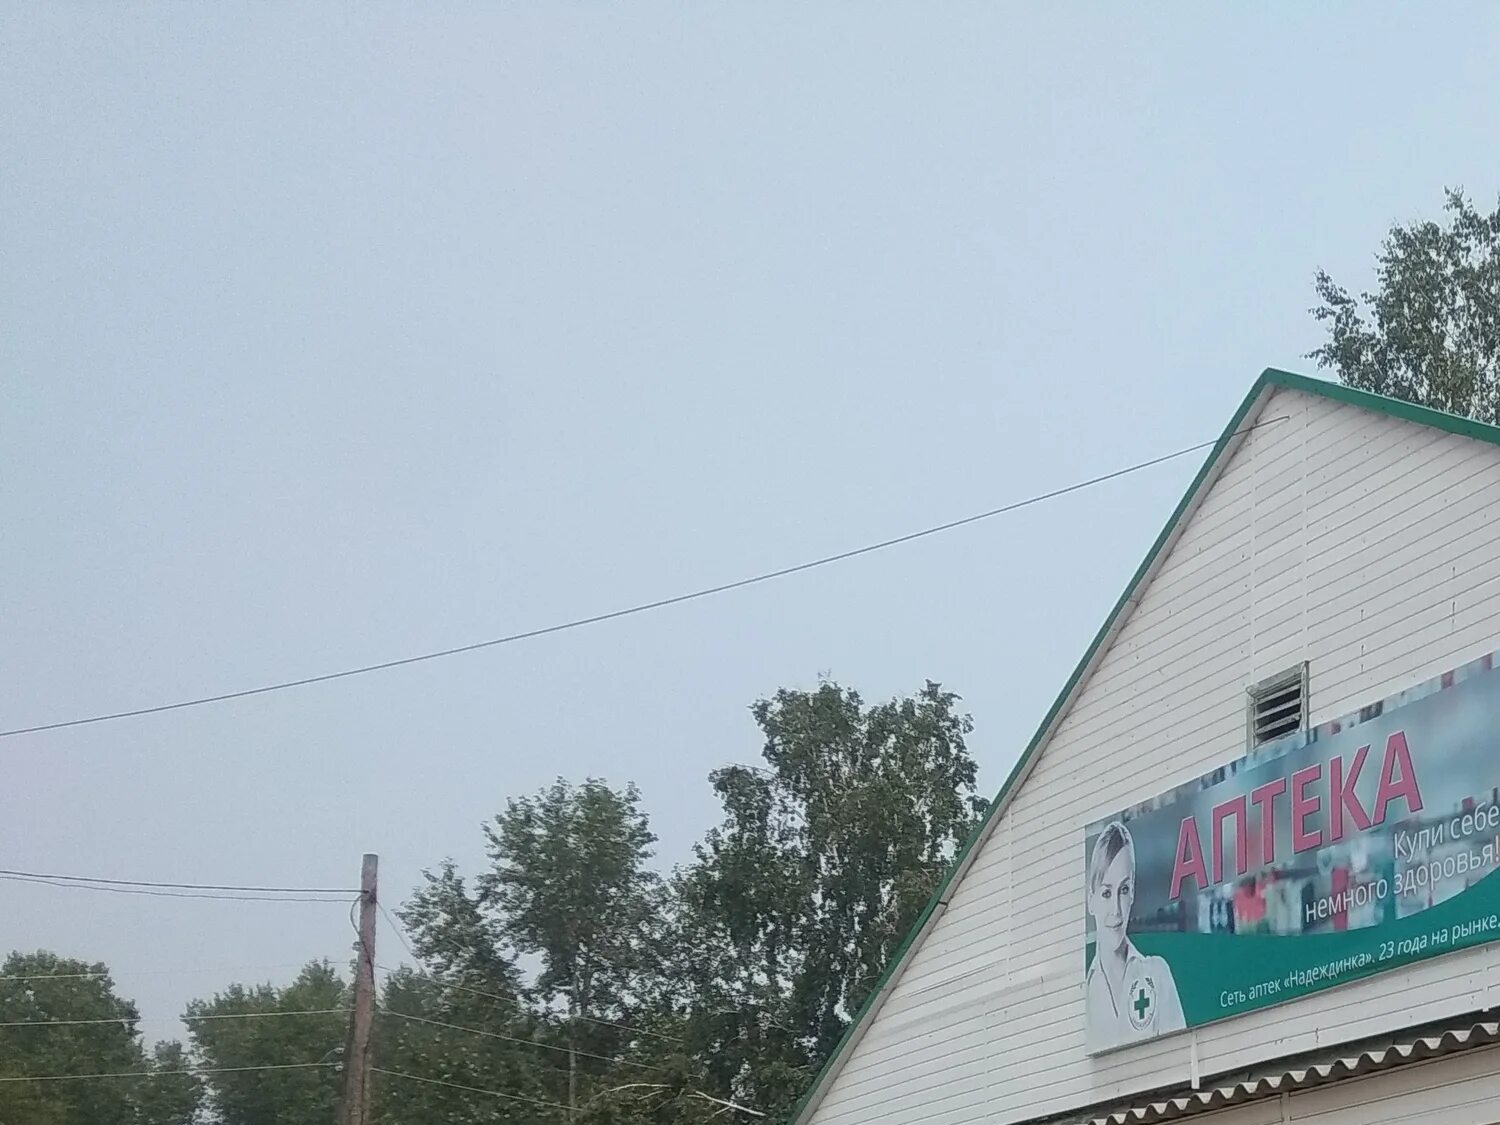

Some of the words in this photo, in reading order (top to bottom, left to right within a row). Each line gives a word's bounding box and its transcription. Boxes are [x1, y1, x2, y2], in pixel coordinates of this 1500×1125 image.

[1169, 730, 1424, 900] АПТЕКА
[1393, 825, 1445, 860] Купи
[1450, 804, 1500, 839] себе
[1305, 879, 1388, 923] немного
[1392, 837, 1500, 897] здоровья!
[1220, 990, 1246, 1008] Сеть
[1249, 982, 1281, 1002] аптек
[1379, 941, 1394, 962] 23
[1397, 933, 1428, 955] года
[1431, 928, 1448, 945] на
